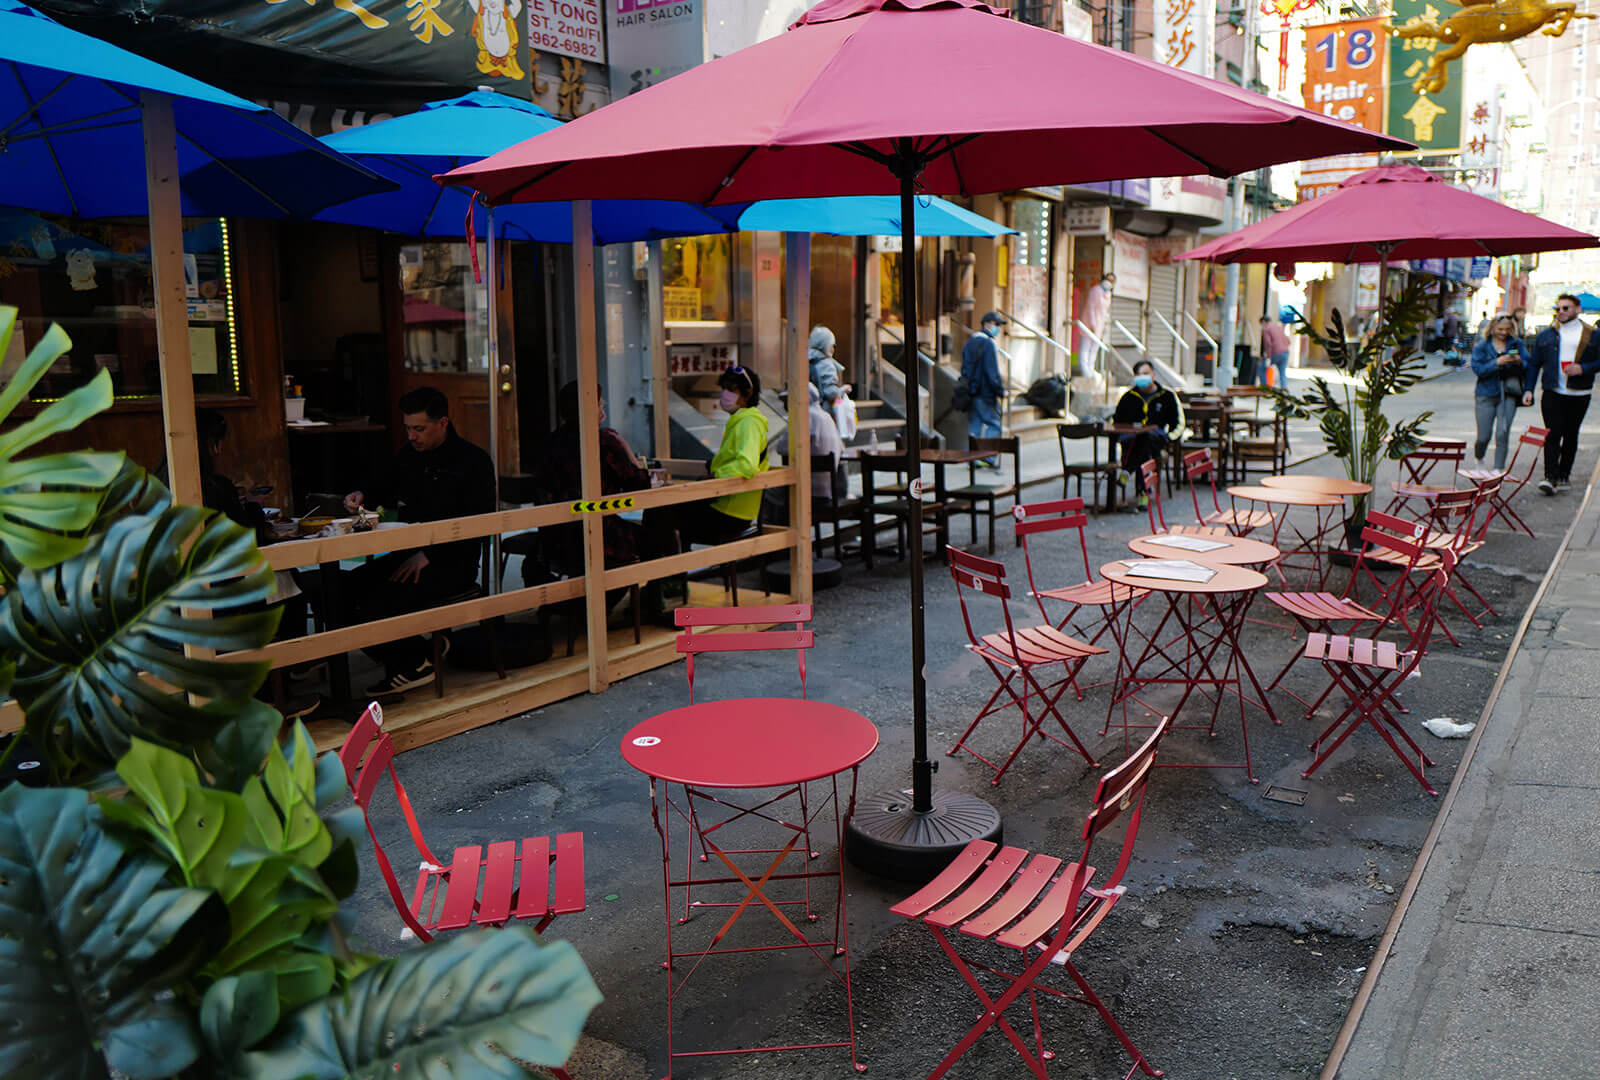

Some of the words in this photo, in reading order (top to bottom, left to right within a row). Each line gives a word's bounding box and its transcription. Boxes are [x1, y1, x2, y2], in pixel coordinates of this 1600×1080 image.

[531, 14, 553, 31] ST.
[550, 0, 598, 25] TONG
[616, 12, 646, 28] HAIR
[650, 4, 693, 22] SALON
[1316, 29, 1376, 73] 18
[1313, 80, 1369, 103] Hair
[1324, 102, 1356, 121] Le
